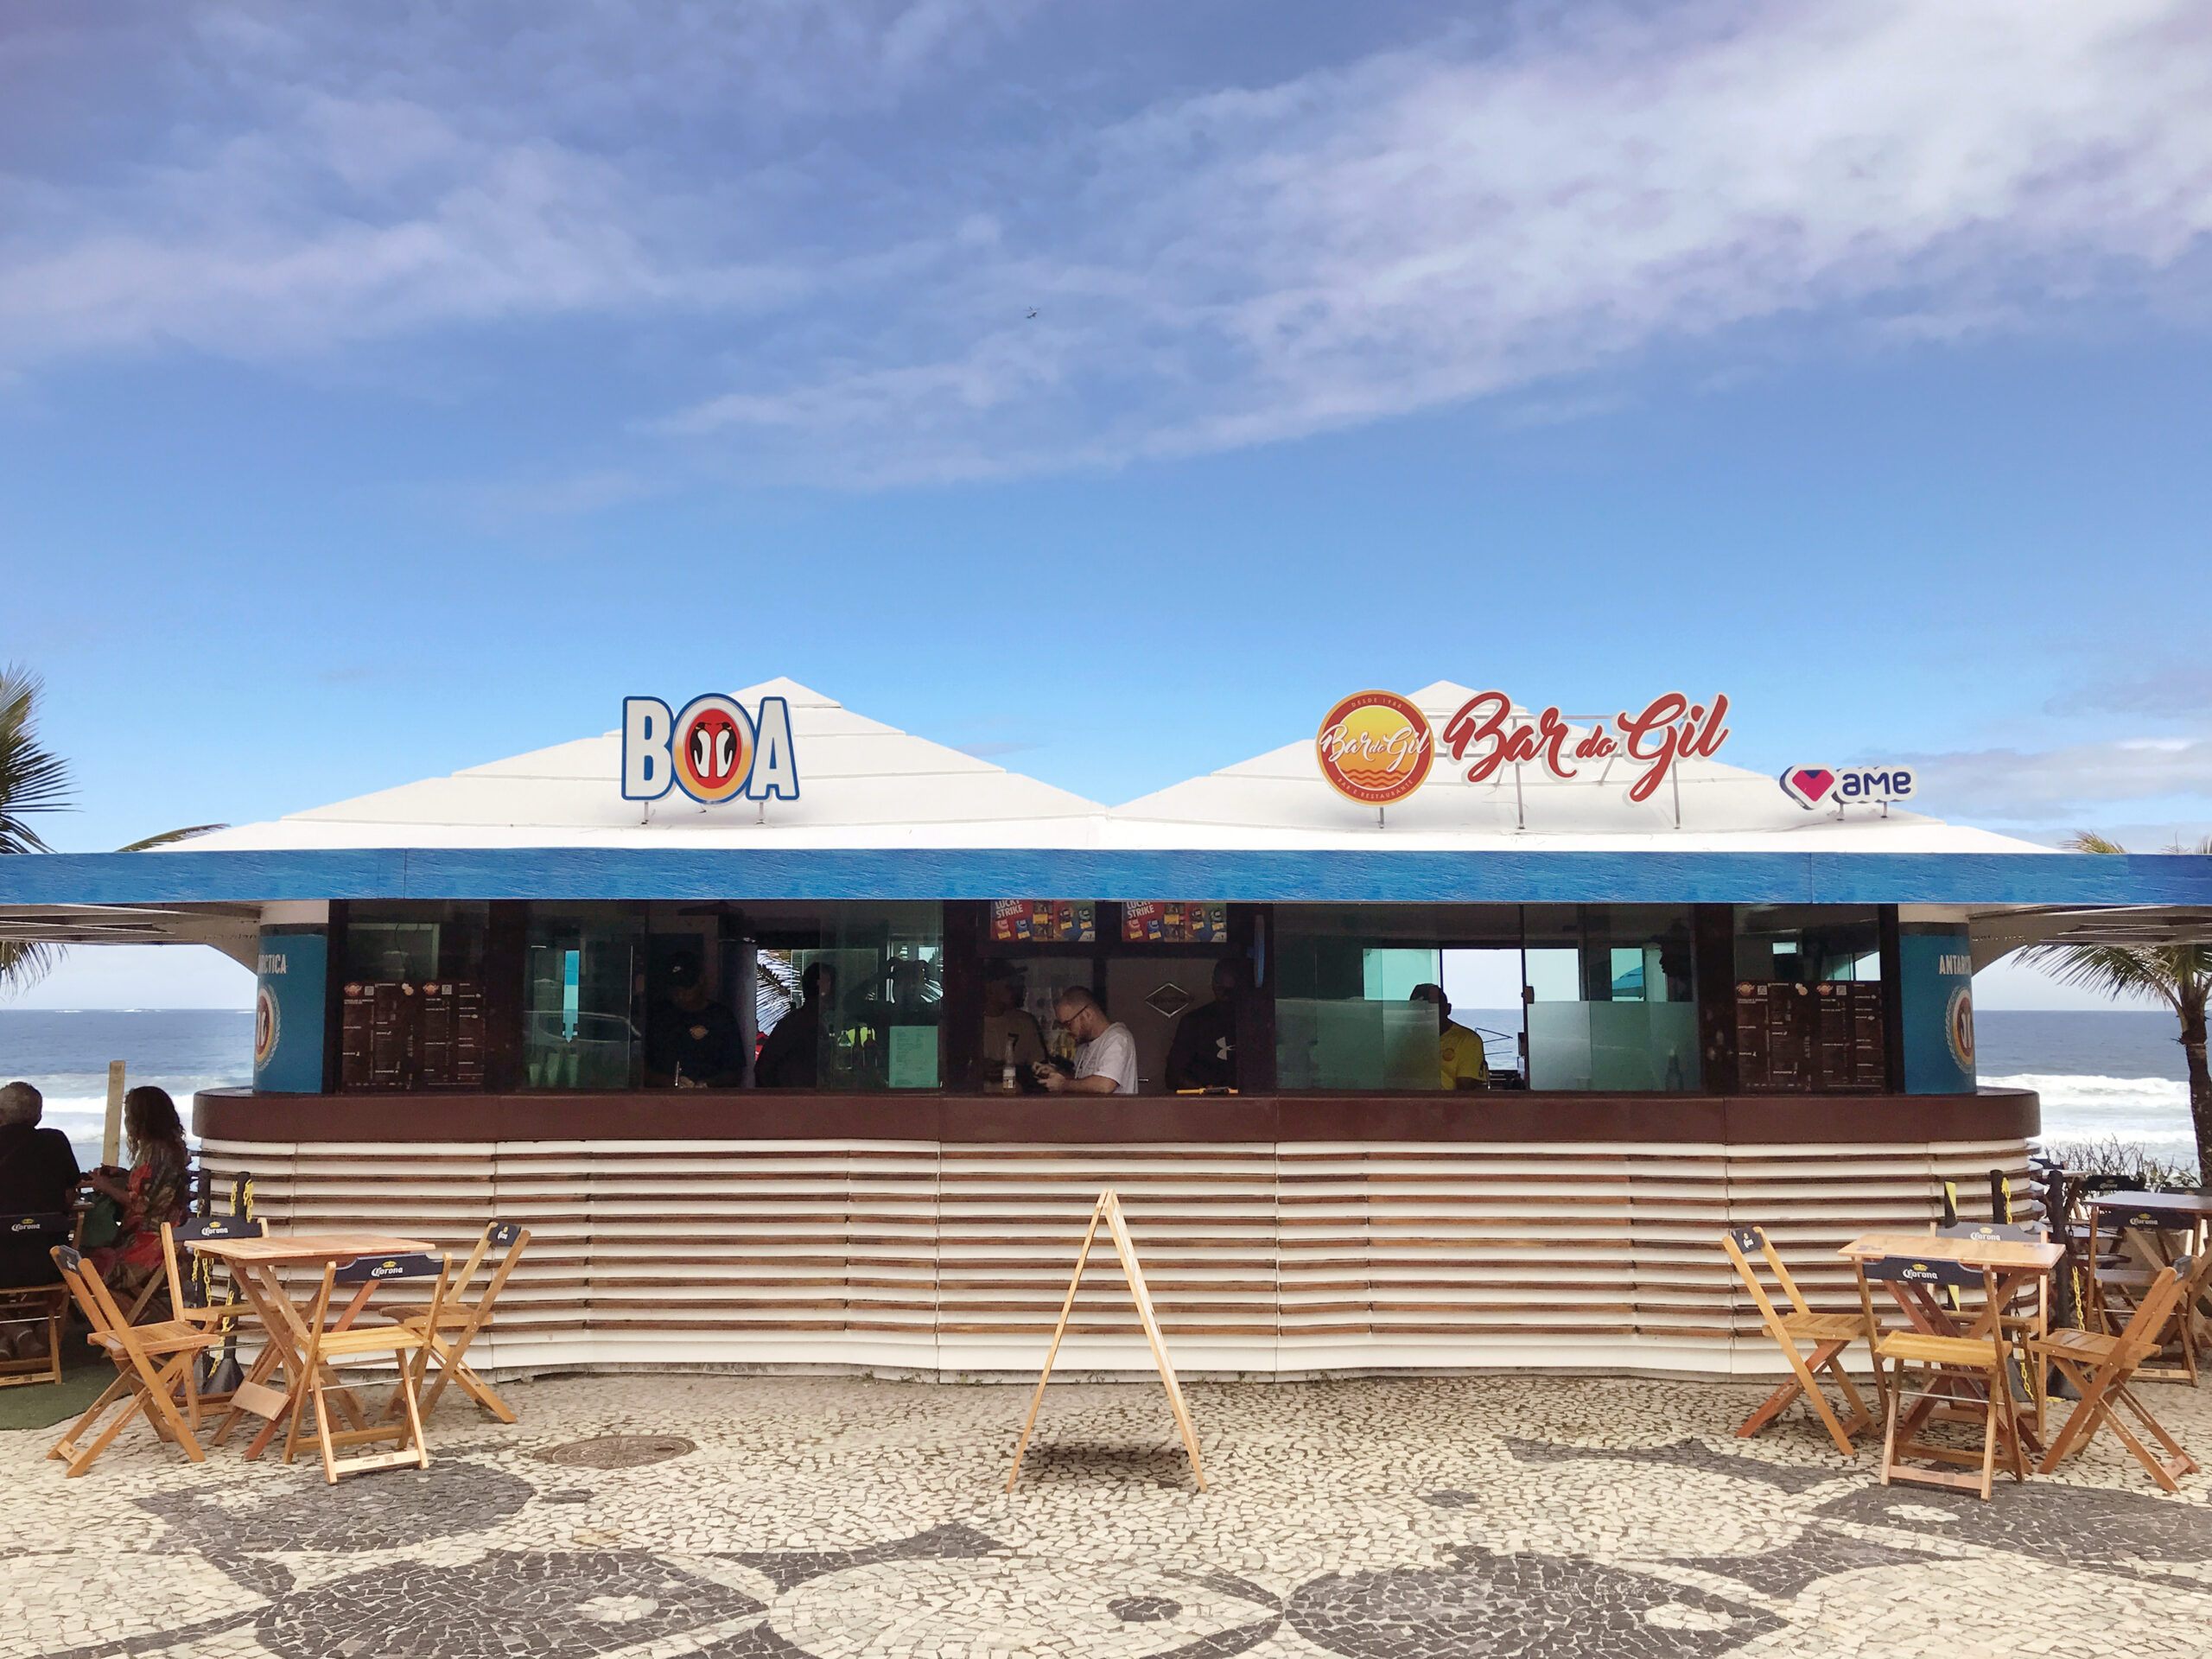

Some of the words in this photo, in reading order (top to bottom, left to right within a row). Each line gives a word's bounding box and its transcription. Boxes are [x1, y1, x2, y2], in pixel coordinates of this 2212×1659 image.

[1351, 697, 1378, 708] DESDE
[622, 693, 800, 804] BOA
[1319, 723, 1376, 762] Bar
[1370, 741, 1385, 754] do
[1382, 726, 1430, 773] Gil
[1442, 690, 1578, 782] Bar
[1575, 724, 1618, 759] do
[1617, 692, 1729, 802] Gil
[1337, 778, 1351, 791] BAR
[1360, 779, 1414, 800] RESTAURANTE
[995, 904, 1024, 918] STRIKE
[1127, 904, 1155, 919] STRIKE
[2129, 1217, 2158, 1225] Corona
[11, 1223, 41, 1232] Corona
[201, 1226, 228, 1236] Corona
[1970, 1231, 2000, 1241] Corona
[371, 1266, 404, 1277] Corona
[1903, 1268, 1938, 1280] Corona
